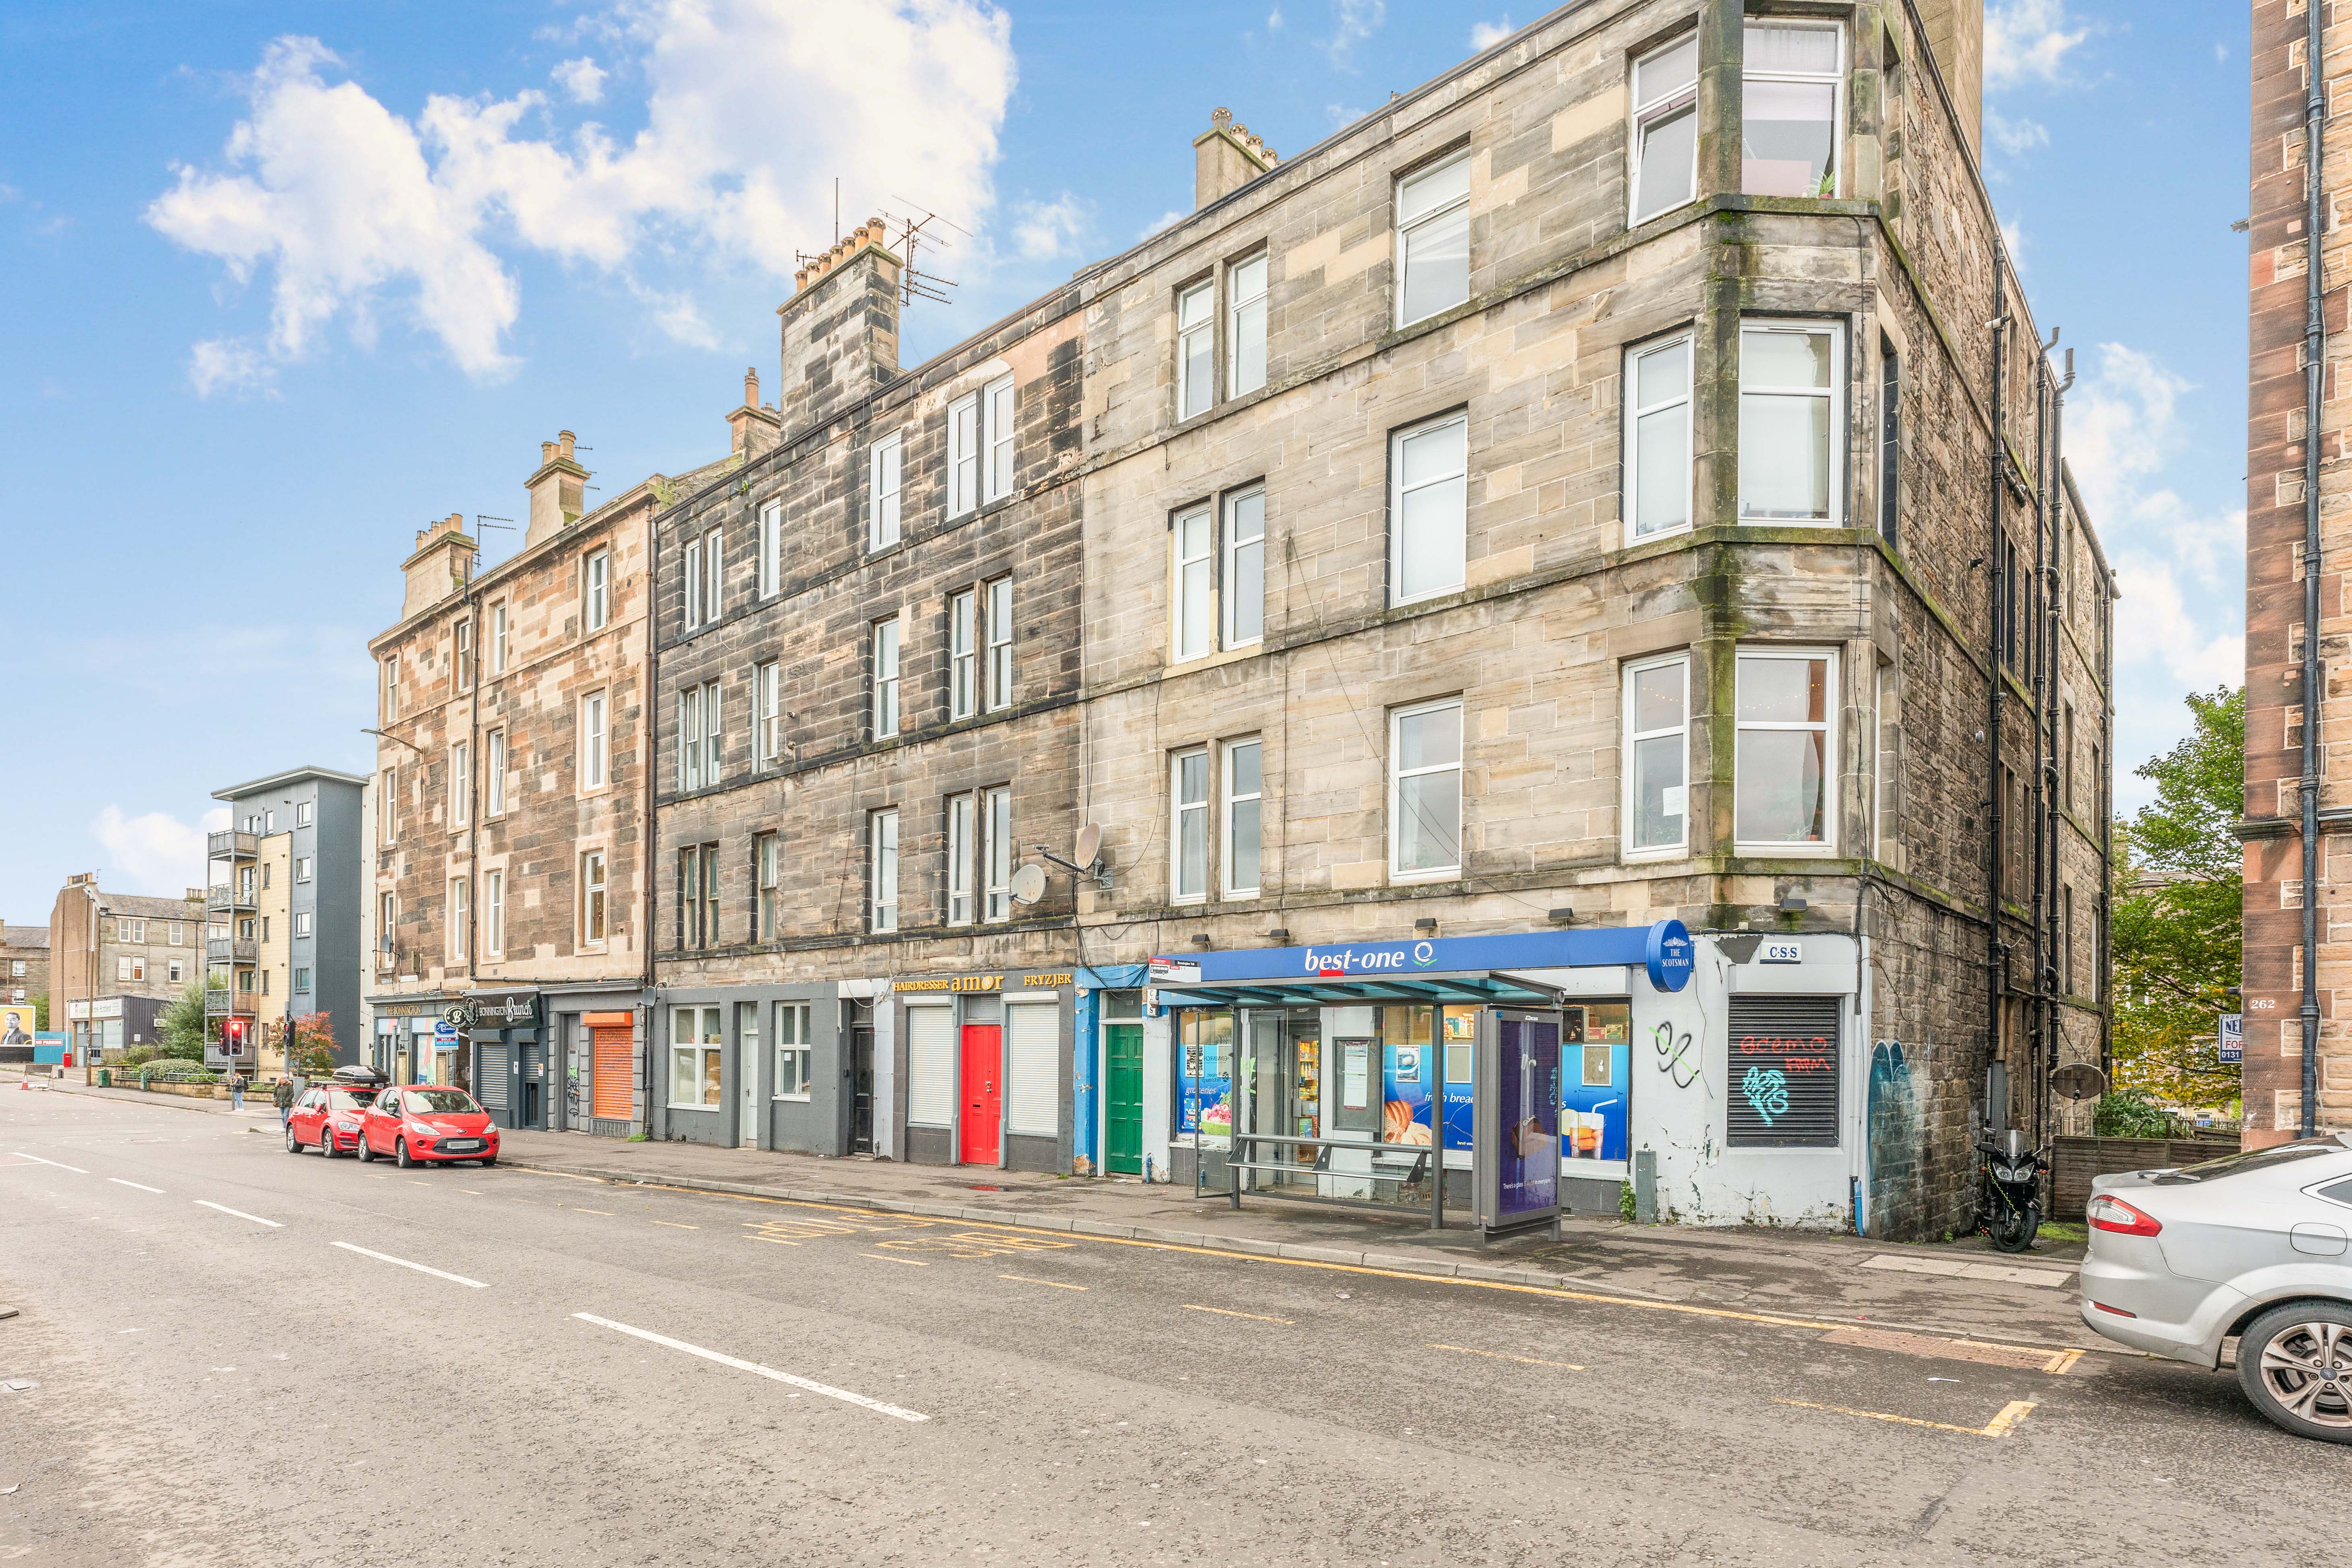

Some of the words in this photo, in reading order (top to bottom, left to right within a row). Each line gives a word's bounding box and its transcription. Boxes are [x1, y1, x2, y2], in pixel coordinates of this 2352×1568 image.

[1670, 948, 1680, 957] THE
[1305, 948, 1405, 971] best-one
[1662, 958, 1689, 967] SCOTSMAN
[893, 980, 949, 991] HAIRDRESSER
[951, 976, 1004, 991] amor
[1024, 973, 1072, 988] FRYZJER
[2251, 999, 2275, 1009] 262
[394, 1005, 421, 1015] BONNINGTON
[479, 1006, 507, 1016] BONNINGTON
[506, 997, 532, 1022] Brunch
[1424, 1091, 1447, 1102] frh
